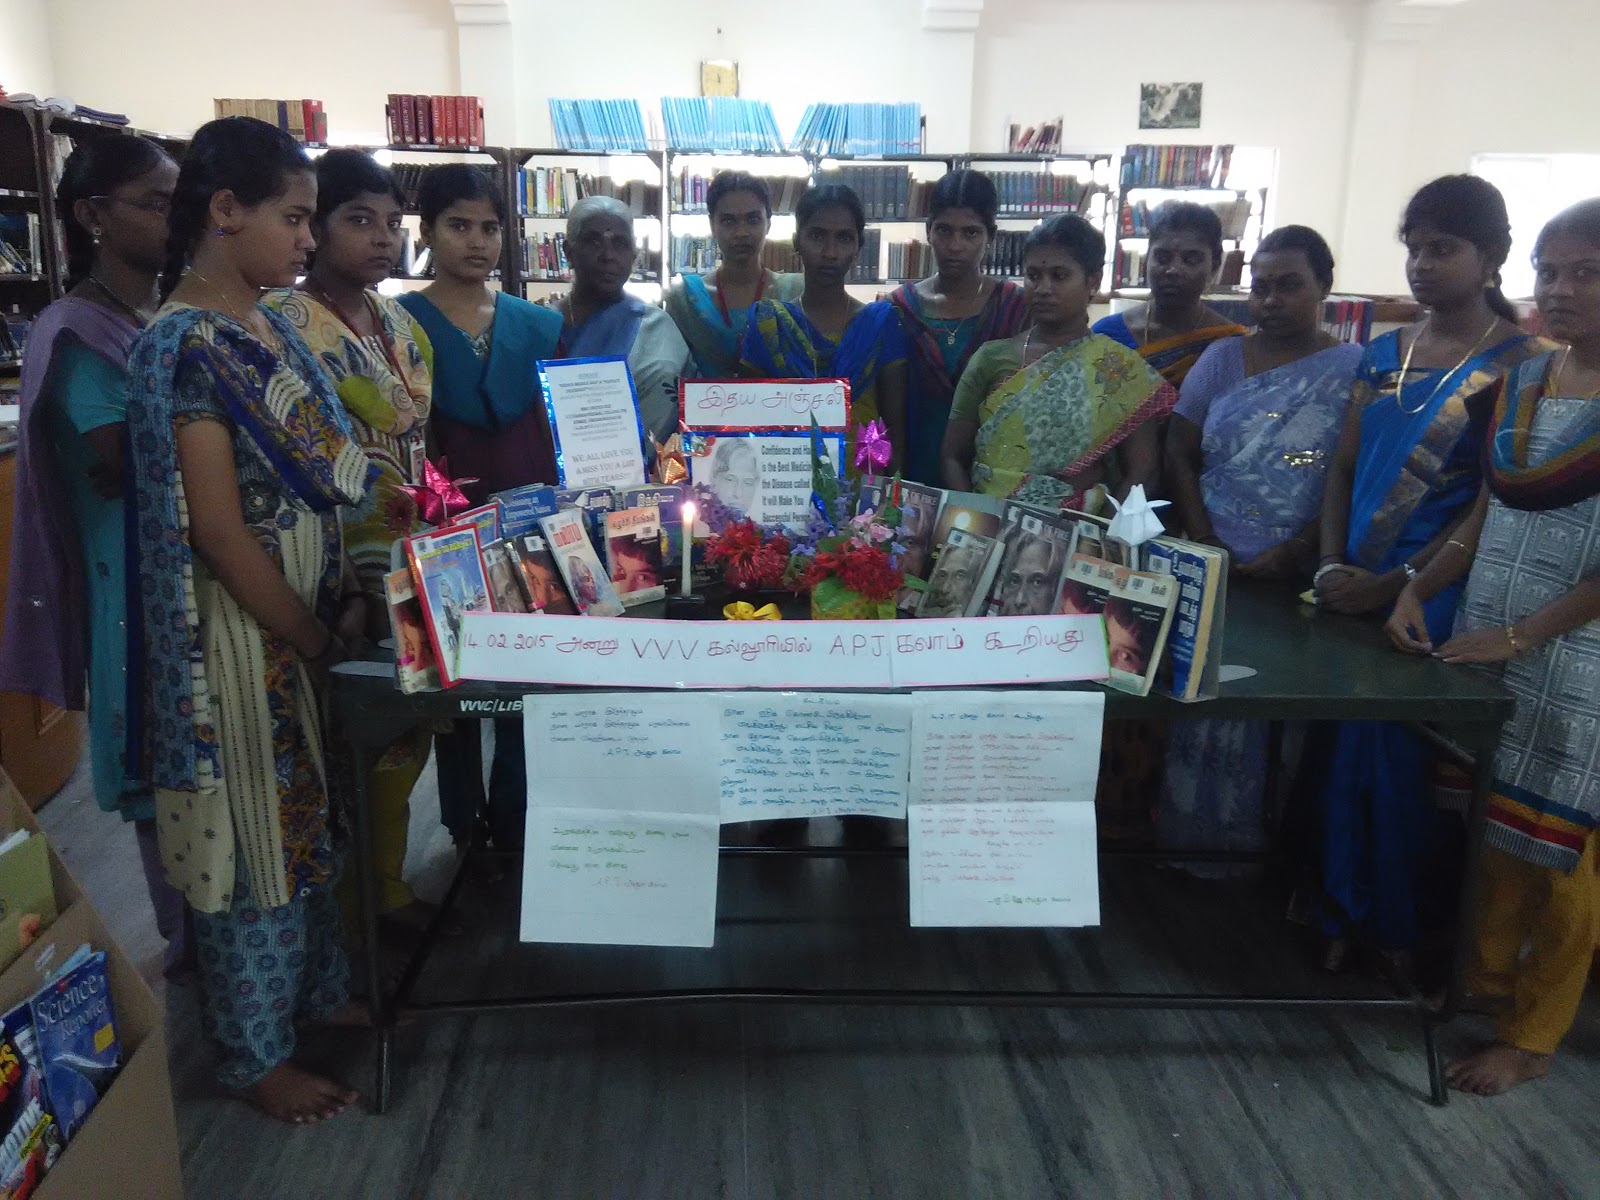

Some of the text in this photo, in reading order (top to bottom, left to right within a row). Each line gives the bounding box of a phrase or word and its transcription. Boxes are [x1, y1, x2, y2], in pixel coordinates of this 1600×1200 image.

[587, 452, 600, 461] ALL
[601, 450, 619, 459] LOVE
[620, 448, 634, 456] YOU
[762, 445, 791, 455] Confidence
[792, 445, 802, 455] and
[768, 462, 776, 472] the
[778, 462, 790, 472] Best
[791, 462, 812, 472] Medicin
[762, 479, 810, 489] the Disease called
[768, 496, 777, 505] will
[779, 495, 792, 505] Make
[793, 495, 804, 505] You
[36, 974, 101, 1032] Science
